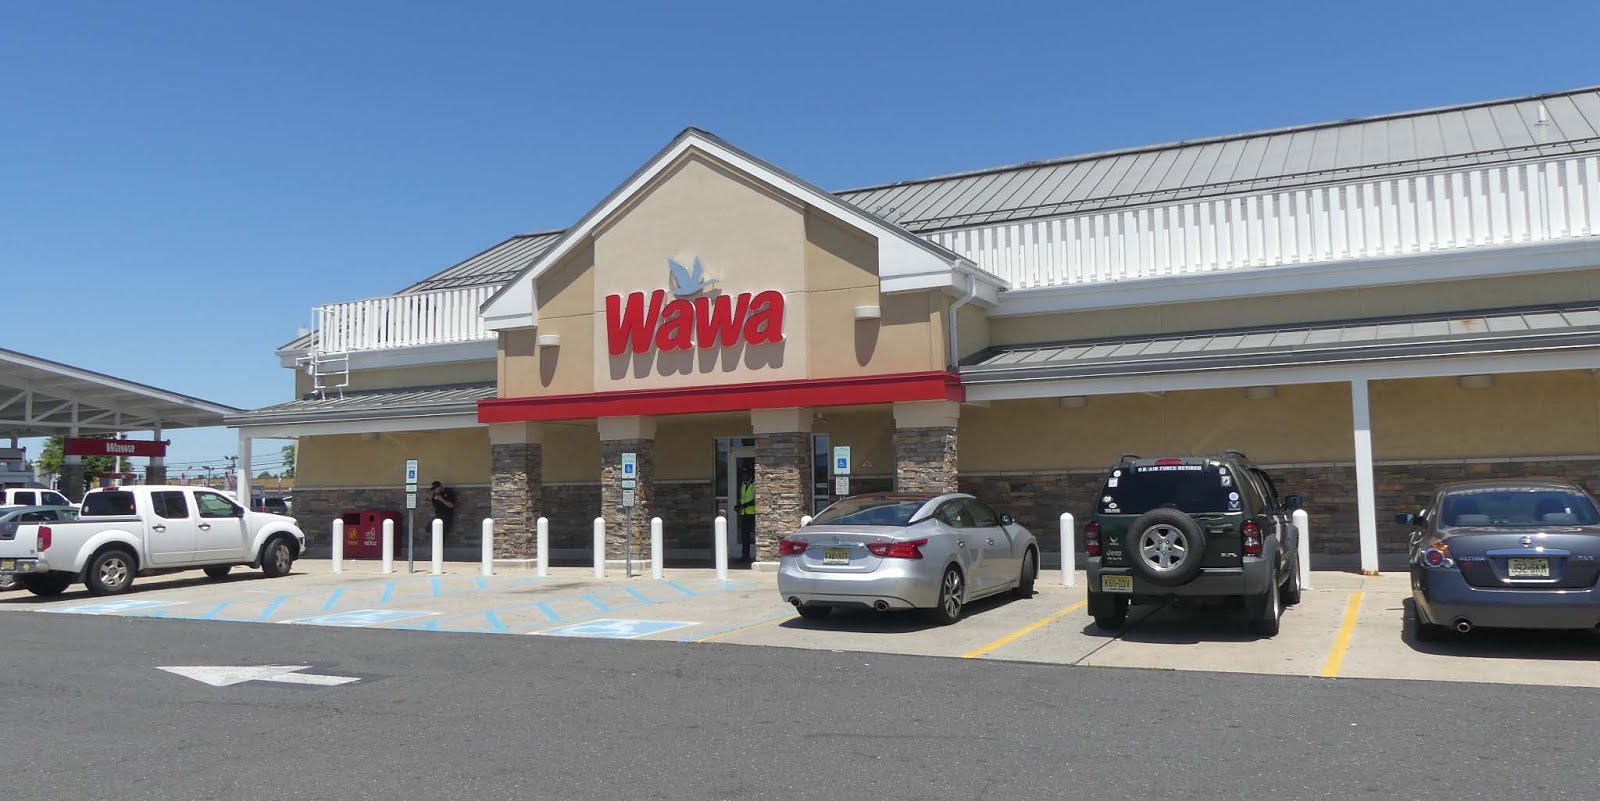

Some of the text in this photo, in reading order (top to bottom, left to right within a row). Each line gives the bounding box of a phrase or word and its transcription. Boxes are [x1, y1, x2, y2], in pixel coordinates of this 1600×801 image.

[605, 288, 786, 356] Wawa
[106, 442, 136, 453] Wawa
[1106, 549, 1122, 557] Jeep
